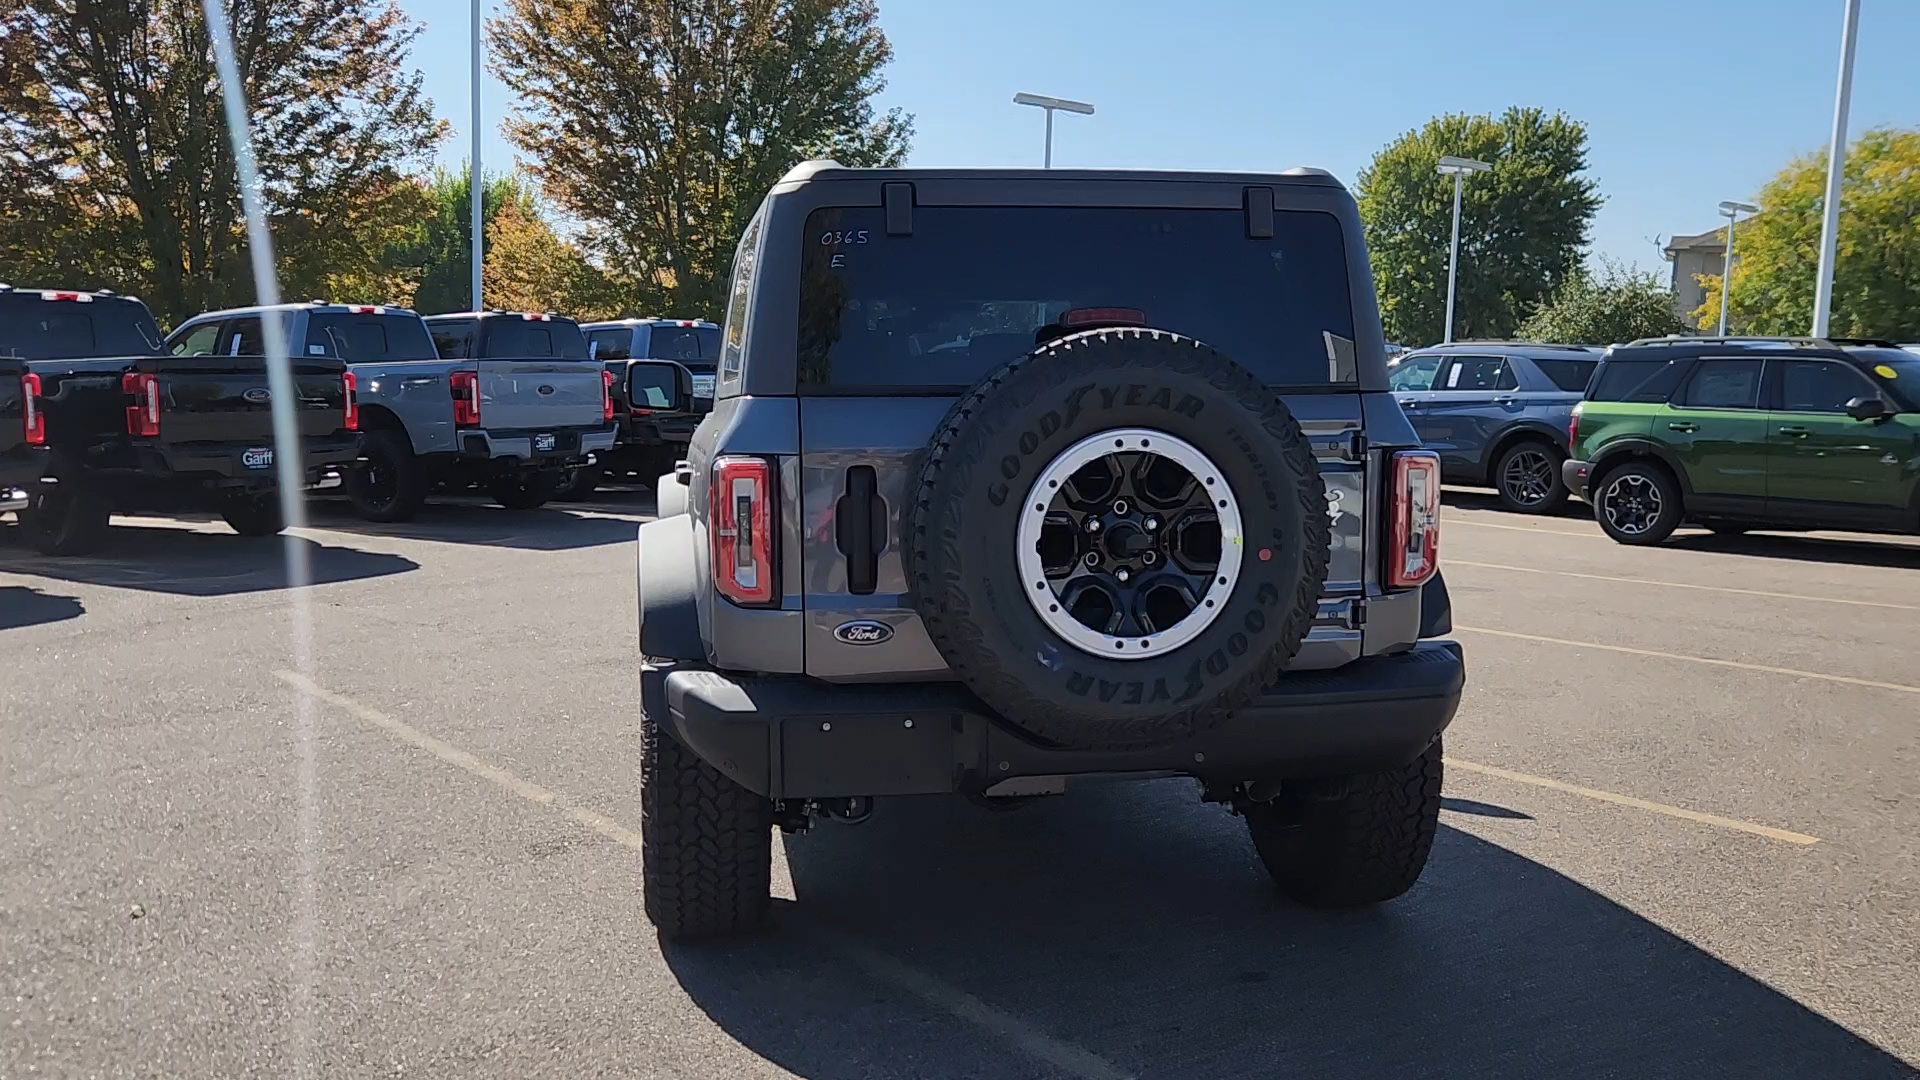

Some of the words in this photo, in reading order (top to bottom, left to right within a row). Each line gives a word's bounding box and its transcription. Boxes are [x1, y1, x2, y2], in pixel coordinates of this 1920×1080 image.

[821, 230, 869, 245] 0365
[830, 254, 845, 268] E
[987, 382, 1205, 506] GOODYEAR
[242, 451, 273, 465] Garff
[847, 626, 881, 640] Ford
[1066, 581, 1279, 705] GOODYEAR
